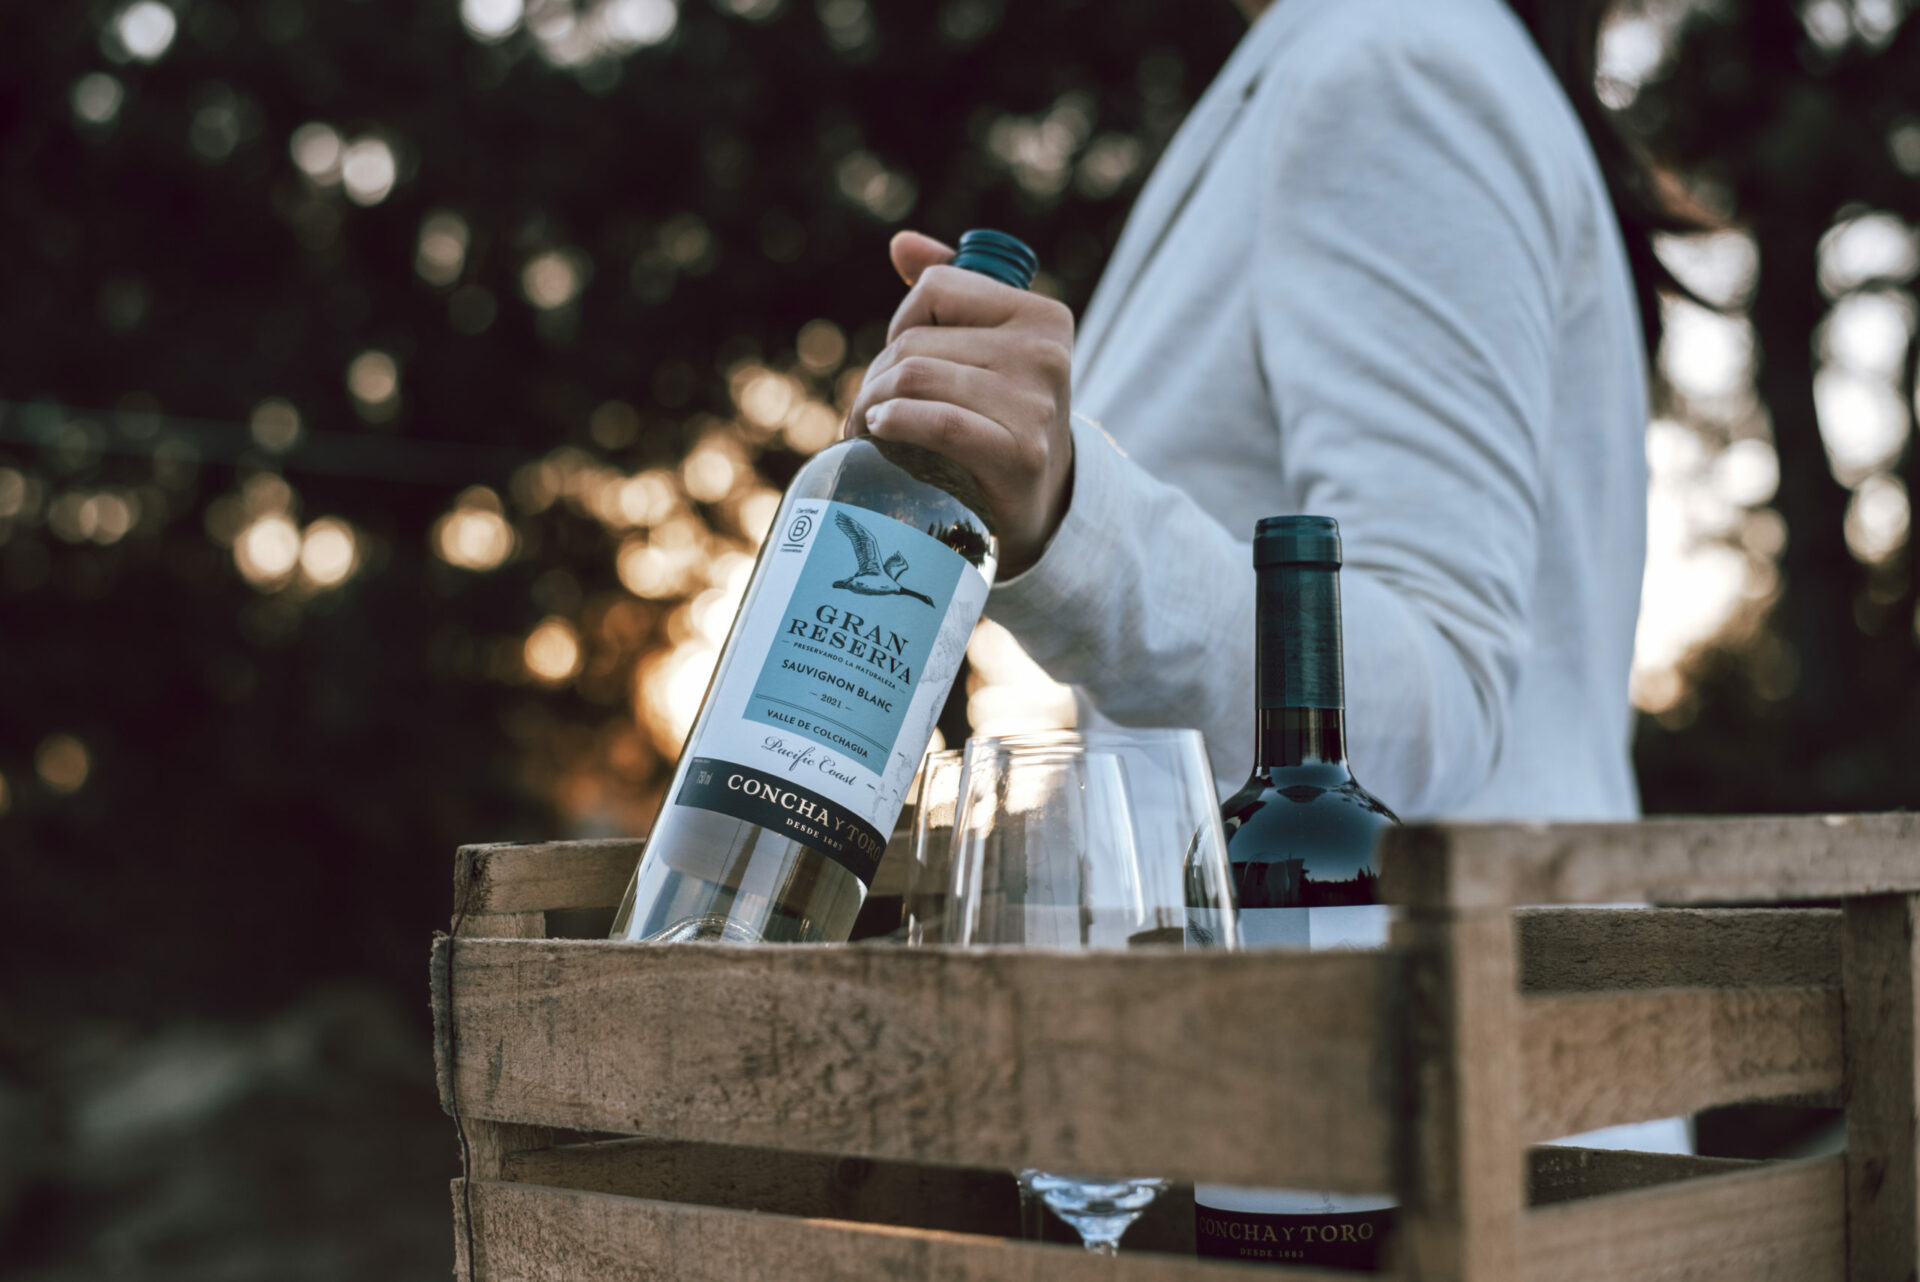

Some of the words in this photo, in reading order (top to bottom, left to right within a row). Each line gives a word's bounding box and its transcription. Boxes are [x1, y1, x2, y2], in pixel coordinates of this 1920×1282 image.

[787, 618, 911, 685] RESERVA
[815, 604, 909, 656] GRAN
[781, 658, 855, 693] SAUVIGNON
[856, 686, 893, 713] BLANC
[793, 641, 844, 663] PRESERVANDO
[845, 659, 854, 668] LA
[855, 664, 896, 689] NATURALEZA
[820, 693, 843, 709] 2021
[767, 708, 796, 726] VALLE
[797, 719, 811, 731] DE
[812, 725, 869, 759] COLCHAGUA
[761, 735, 816, 772] Pacific
[818, 755, 857, 787] Coast
[727, 773, 830, 828] CONCHA
[834, 816, 846, 832] Y
[846, 824, 881, 862] TORO
[786, 817, 820, 839] DESDE
[1199, 1216, 1279, 1242] CONCHA
[1281, 1226, 1295, 1241] Y
[1300, 1222, 1374, 1243] TORO
[1240, 1247, 1273, 1257] DESDE
